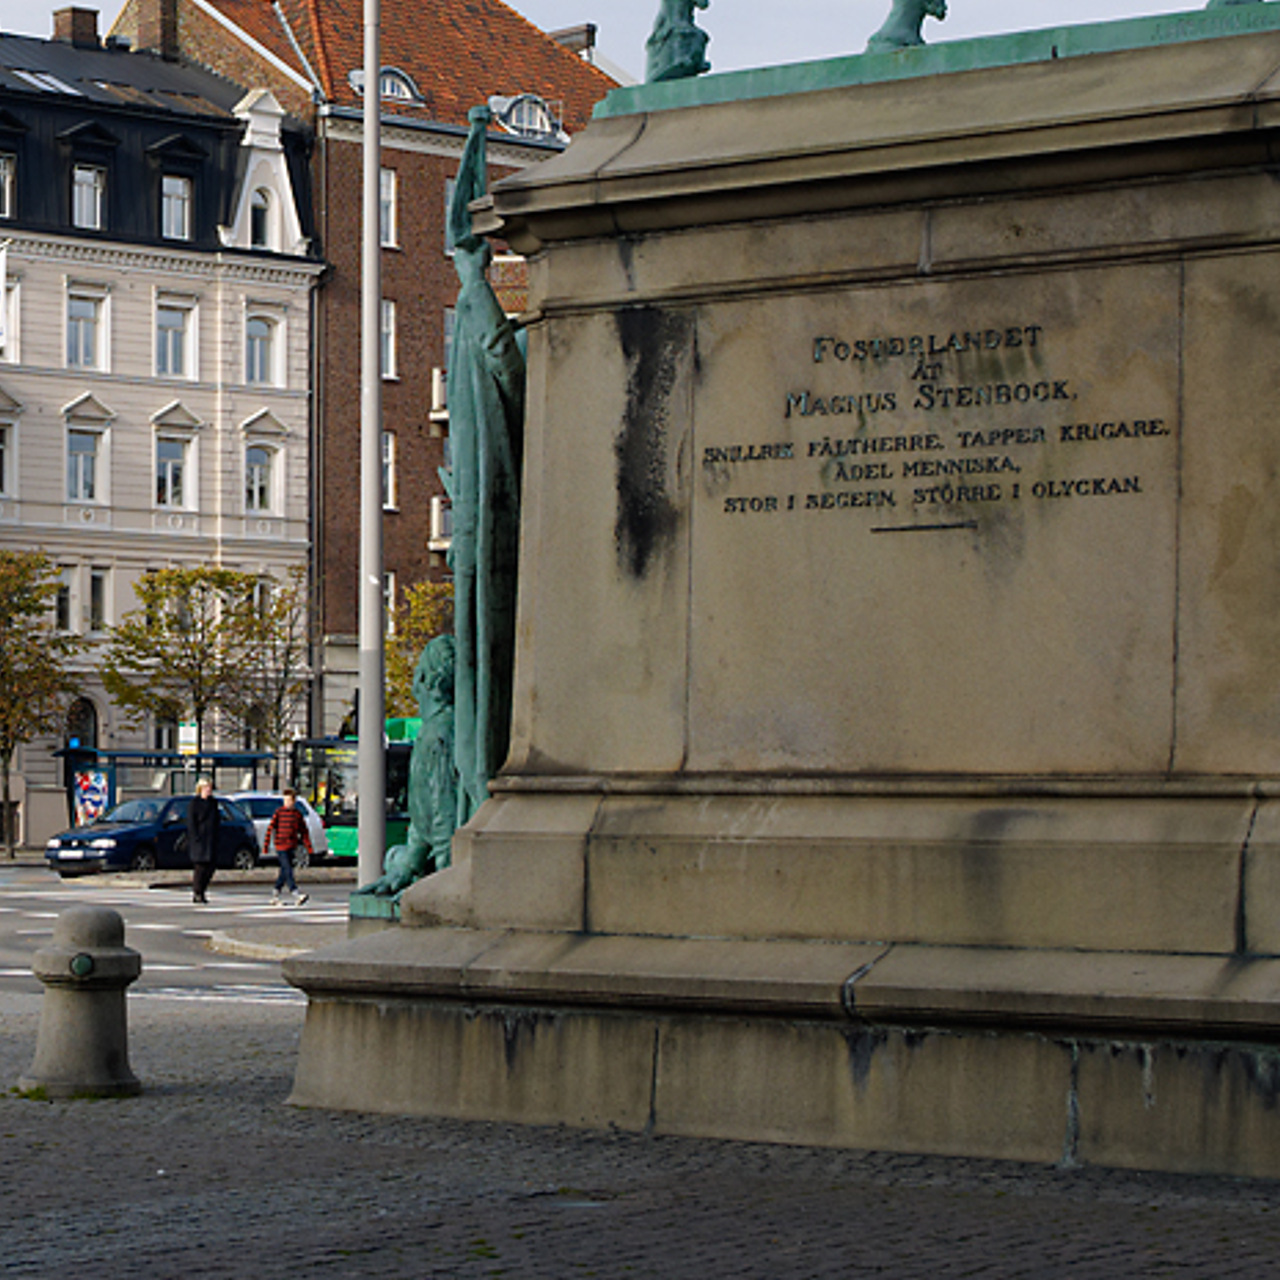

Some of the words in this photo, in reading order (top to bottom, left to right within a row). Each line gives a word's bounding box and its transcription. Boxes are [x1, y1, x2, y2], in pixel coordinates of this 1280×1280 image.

[813, 326, 1042, 363] FOSTERLANDET
[784, 391, 897, 418] MAGNUS
[702, 442, 794, 465] SNILLRIK
[957, 426, 1046, 449] TAPPER
[723, 495, 778, 513] STOR
[786, 494, 795, 511] I
[913, 480, 1002, 504] STÖRRE
[1011, 481, 1021, 499] I
